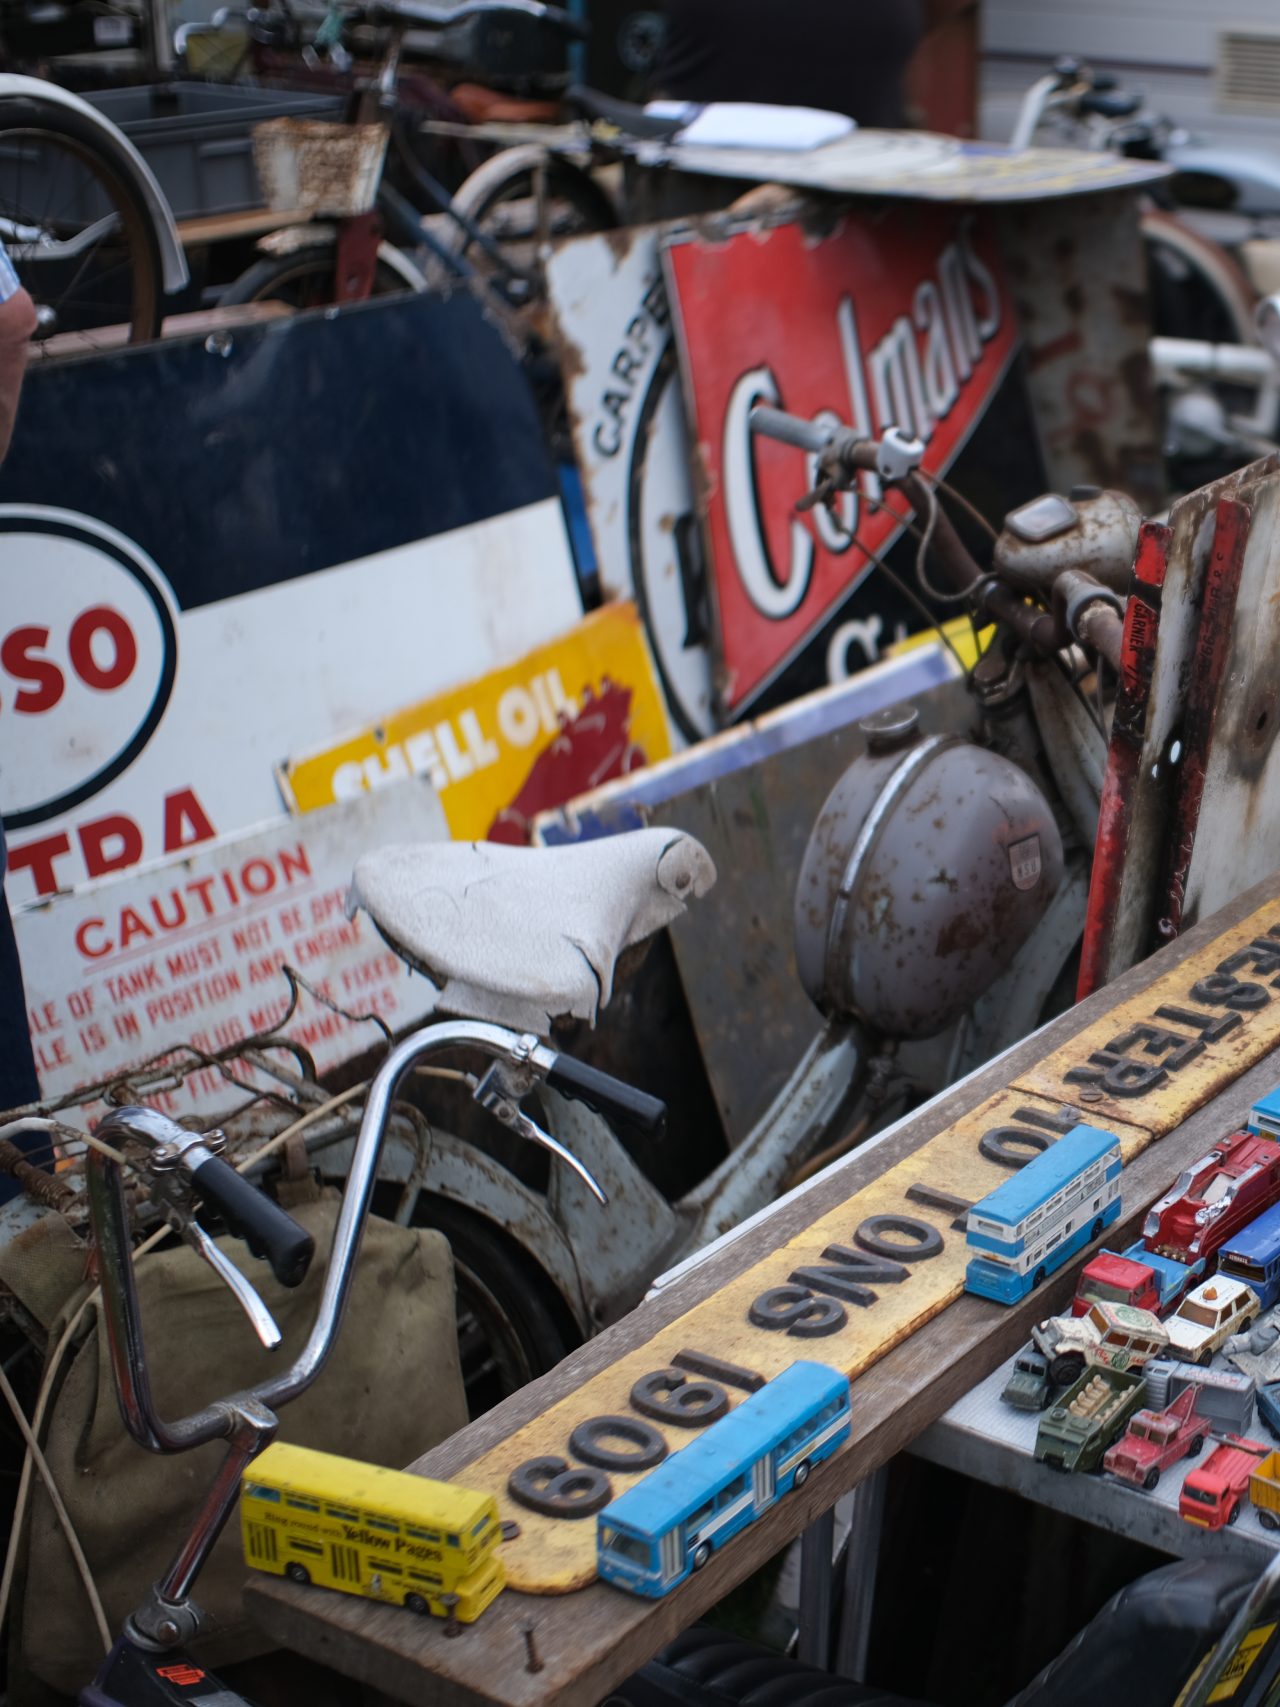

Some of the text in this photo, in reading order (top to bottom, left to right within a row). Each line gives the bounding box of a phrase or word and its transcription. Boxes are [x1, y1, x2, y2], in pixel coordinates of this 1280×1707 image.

[593, 274, 671, 458] CARPE
[0, 603, 138, 715] SO
[29, 885, 348, 1037] LE OF TANK MUST NOT BE OPE
[75, 843, 312, 961] CAUTION
[340, 951, 400, 993] FIXED
[35, 1035, 72, 1074] LE
[79, 1022, 107, 1056] IS
[114, 1009, 141, 1041] IN
[146, 968, 243, 1027] POSITION
[247, 949, 288, 985] AND
[293, 918, 362, 965] ENGINE
[747, 1181, 972, 1340] TONS
[508, 1347, 766, 1520] 1909
[342, 1523, 392, 1551] Yellow
[393, 1537, 444, 1564] Pages
